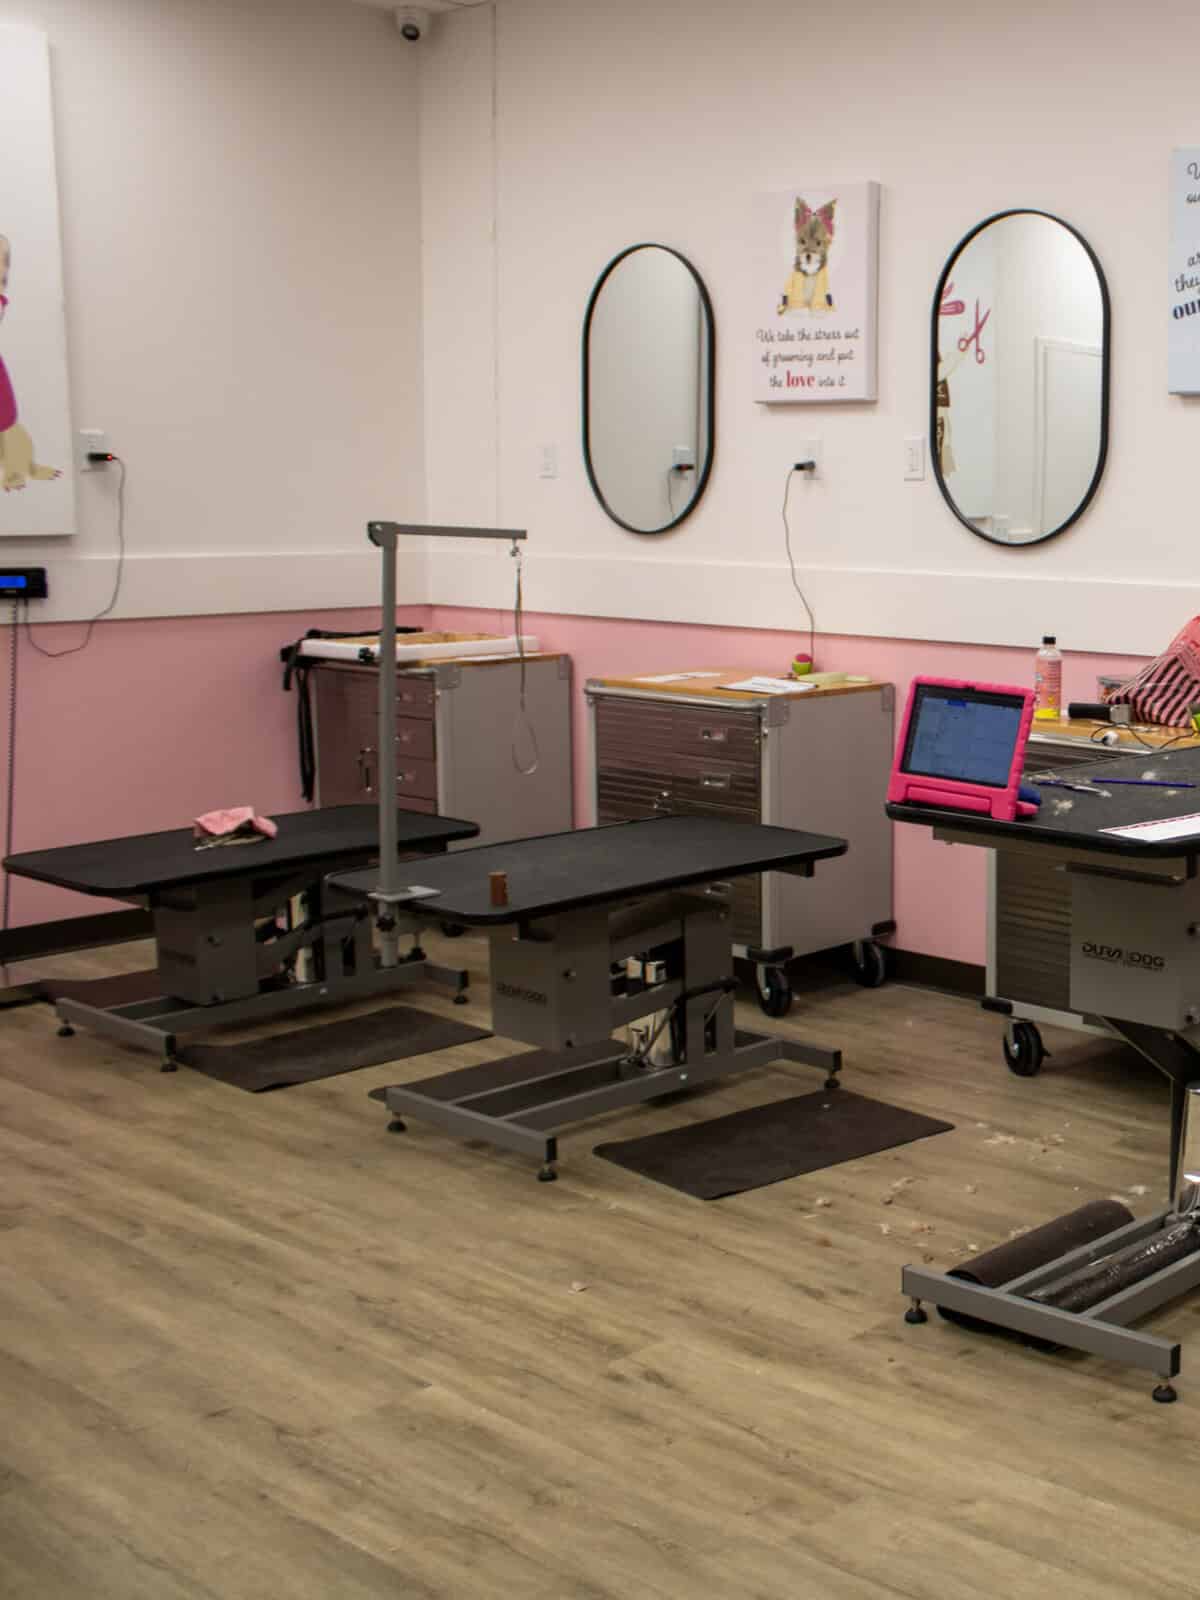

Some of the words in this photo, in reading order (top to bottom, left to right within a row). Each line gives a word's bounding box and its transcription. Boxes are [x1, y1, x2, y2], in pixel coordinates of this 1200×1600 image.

[756, 328, 775, 342] We
[777, 328, 795, 341] take
[797, 328, 811, 341] the
[814, 328, 842, 340] stress
[844, 328, 860, 339] out
[761, 351, 770, 367] of
[772, 352, 814, 368] grooming
[816, 347, 836, 361] and
[838, 349, 854, 364] put
[769, 375, 783, 387] the
[786, 369, 815, 388] love
[818, 376, 836, 387] into
[838, 375, 846, 387] it
[1128, 951, 1165, 968] DOG
